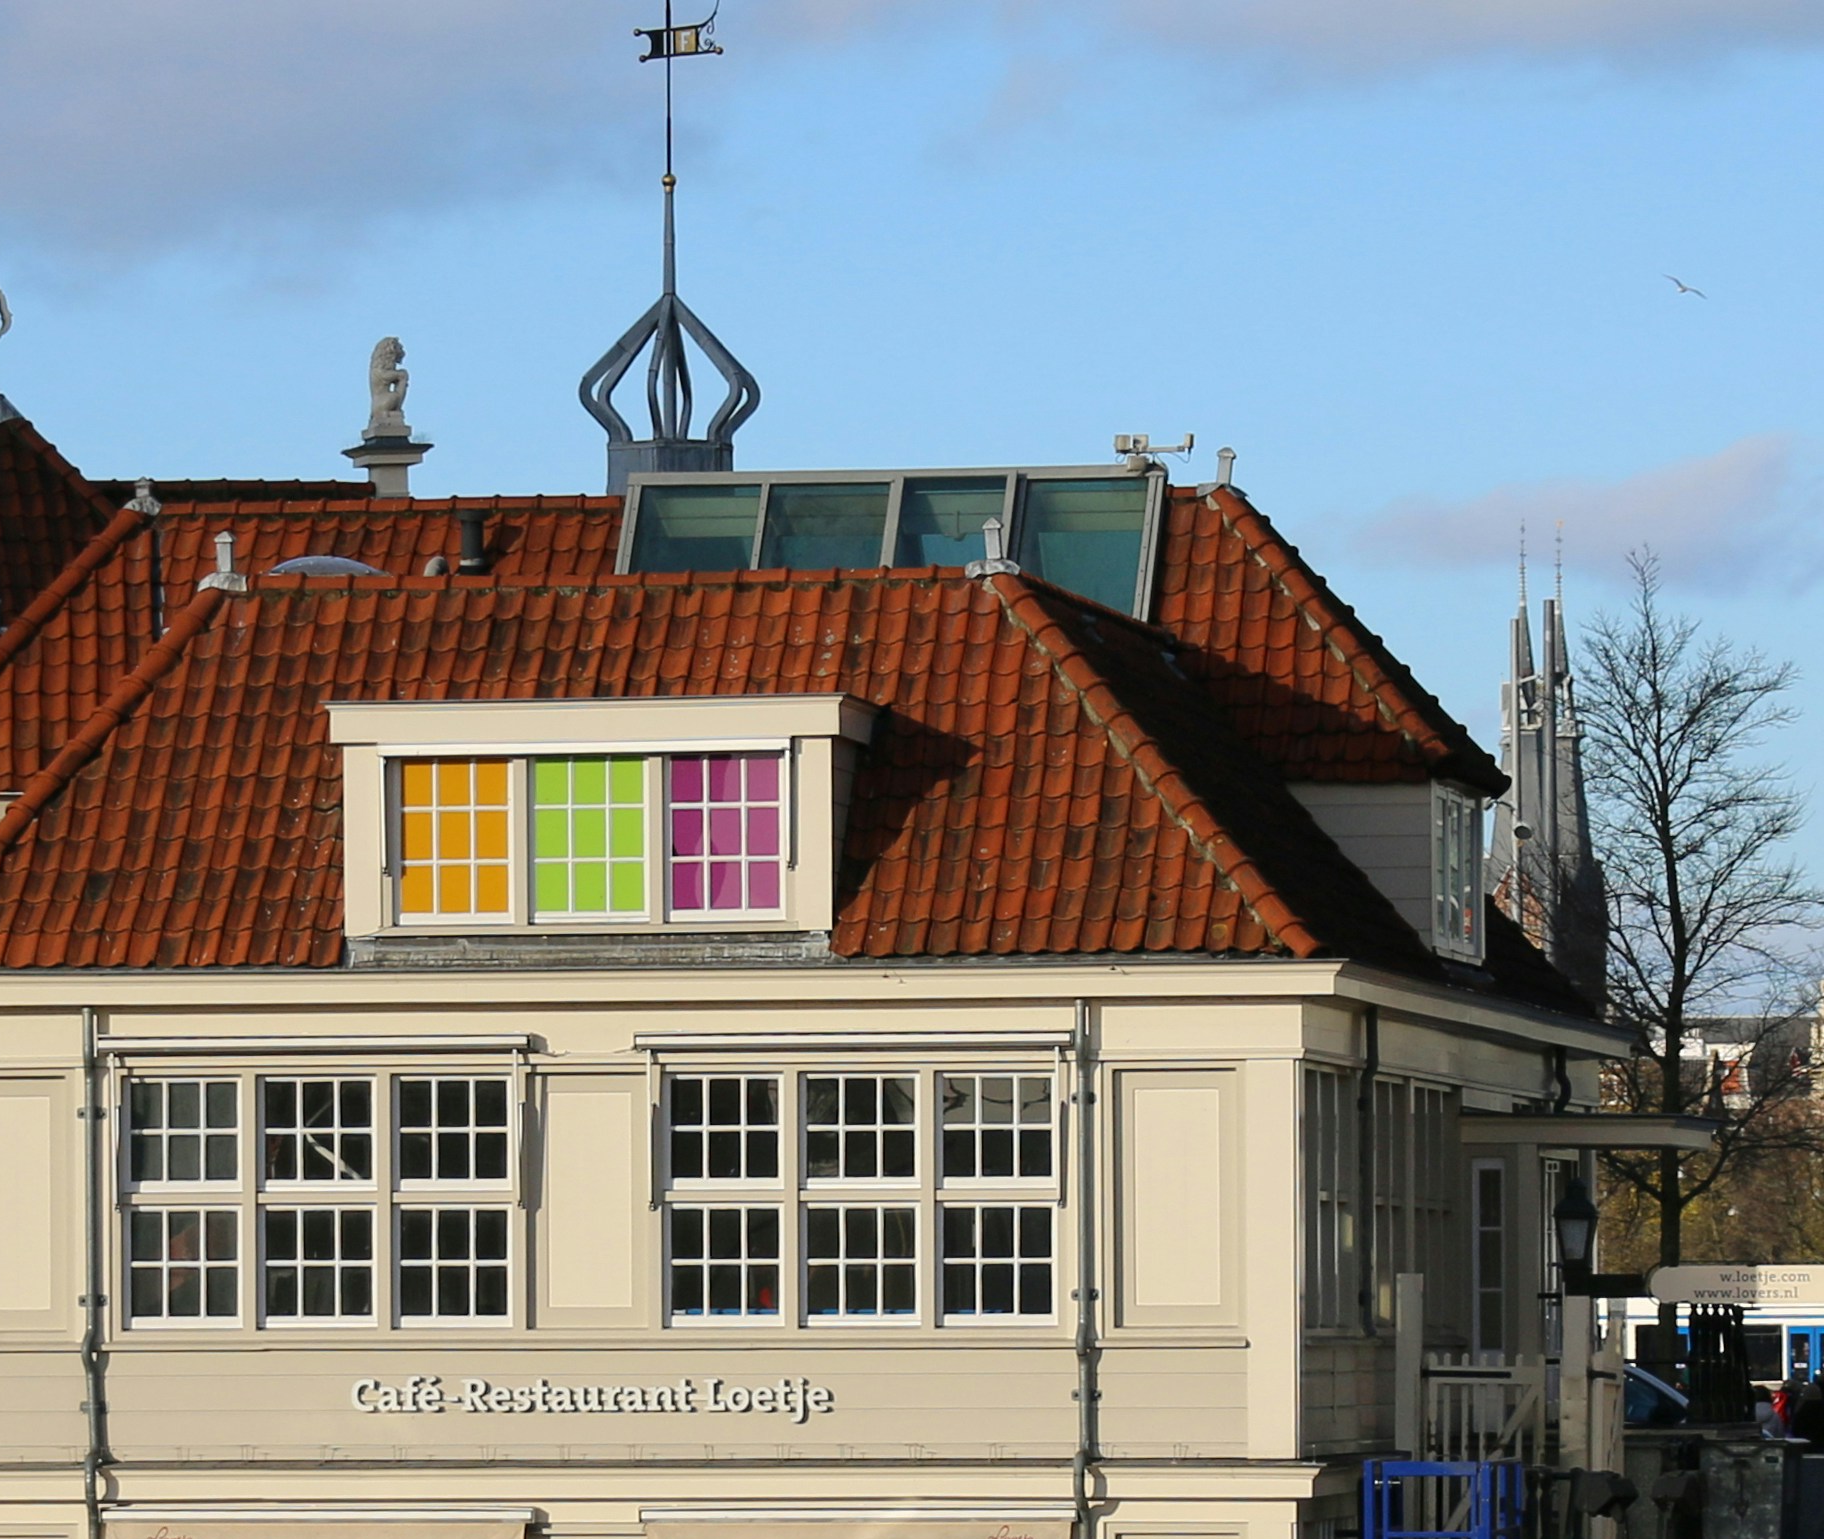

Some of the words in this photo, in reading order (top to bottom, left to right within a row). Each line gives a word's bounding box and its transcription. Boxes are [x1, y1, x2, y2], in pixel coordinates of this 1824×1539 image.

[1720, 1271, 1811, 1284] w.loetje.com
[1694, 1287, 1799, 1299] www.lovers.nl
[704, 1376, 835, 1424] Loetje
